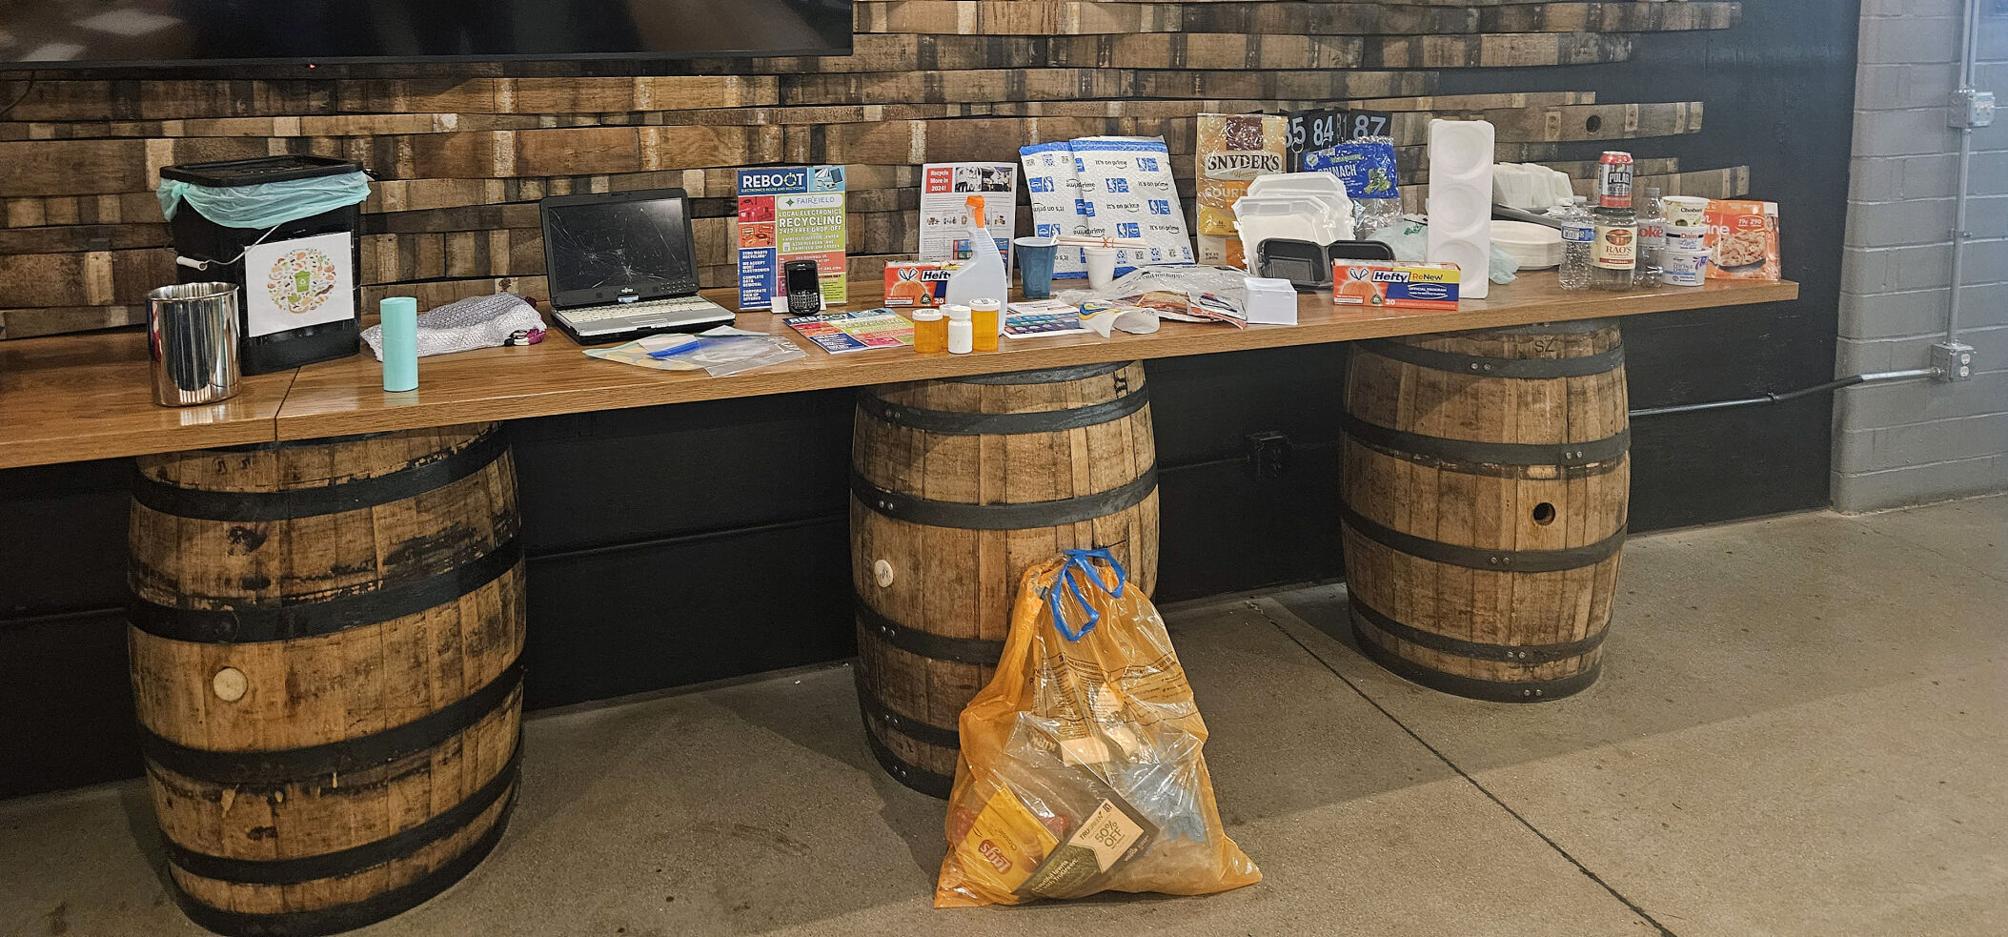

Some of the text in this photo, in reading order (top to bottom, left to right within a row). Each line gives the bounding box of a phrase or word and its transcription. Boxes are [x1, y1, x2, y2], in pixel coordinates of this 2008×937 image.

[1313, 115, 1334, 146] 84
[1353, 115, 1387, 140] 87
[1207, 154, 1280, 172] SNYDER'S
[930, 169, 949, 177] Recycle
[1609, 173, 1630, 183] POLAR
[742, 172, 805, 189] REBOOT
[796, 196, 835, 205] FAIRFIELD
[780, 215, 842, 228] RECYCLING
[1640, 226, 1664, 238] oke
[1711, 225, 1730, 235] ine
[1606, 246, 1632, 254] RAO'S
[1374, 271, 1409, 282] Hefty
[1094, 820, 1118, 843] 50%
[1104, 827, 1122, 847] OFF
